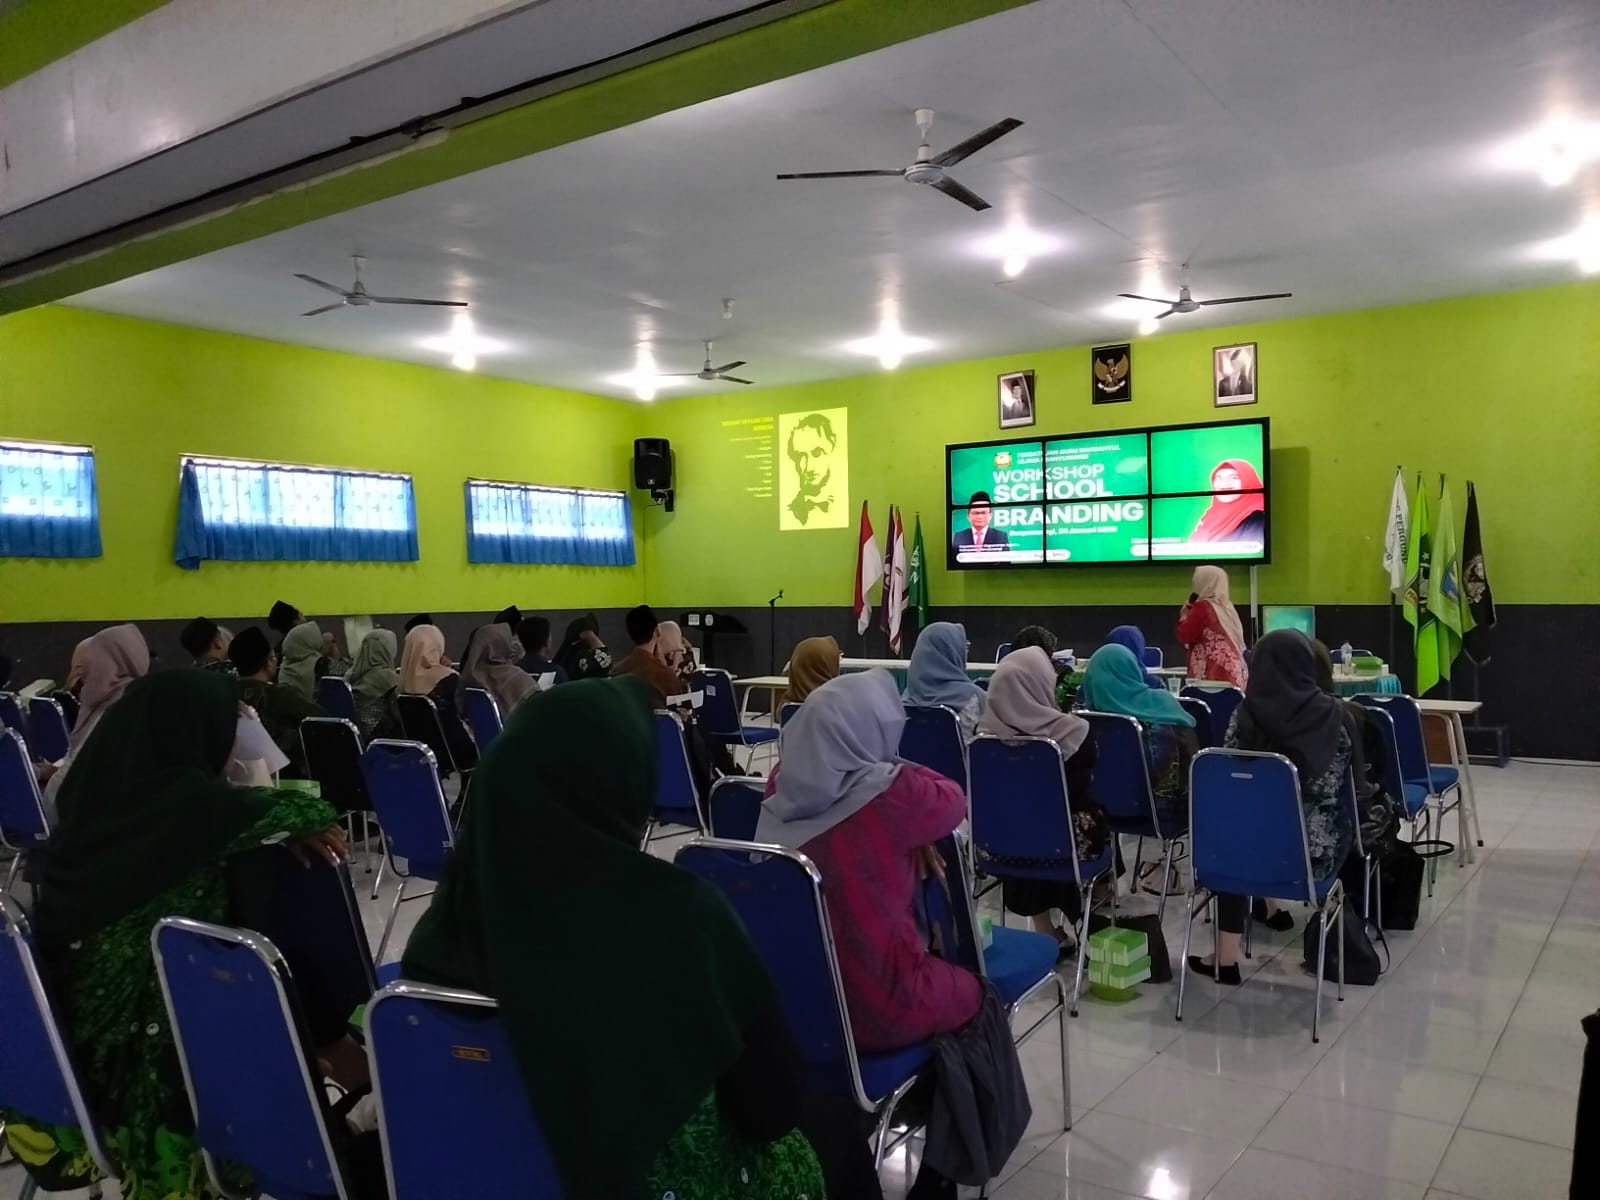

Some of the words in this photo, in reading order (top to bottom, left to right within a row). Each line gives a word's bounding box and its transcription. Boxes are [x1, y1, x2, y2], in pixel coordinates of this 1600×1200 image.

[993, 464, 1105, 484] WORKSHOP
[994, 478, 1113, 504] SCHOOL
[994, 502, 1144, 527] BRANDING
